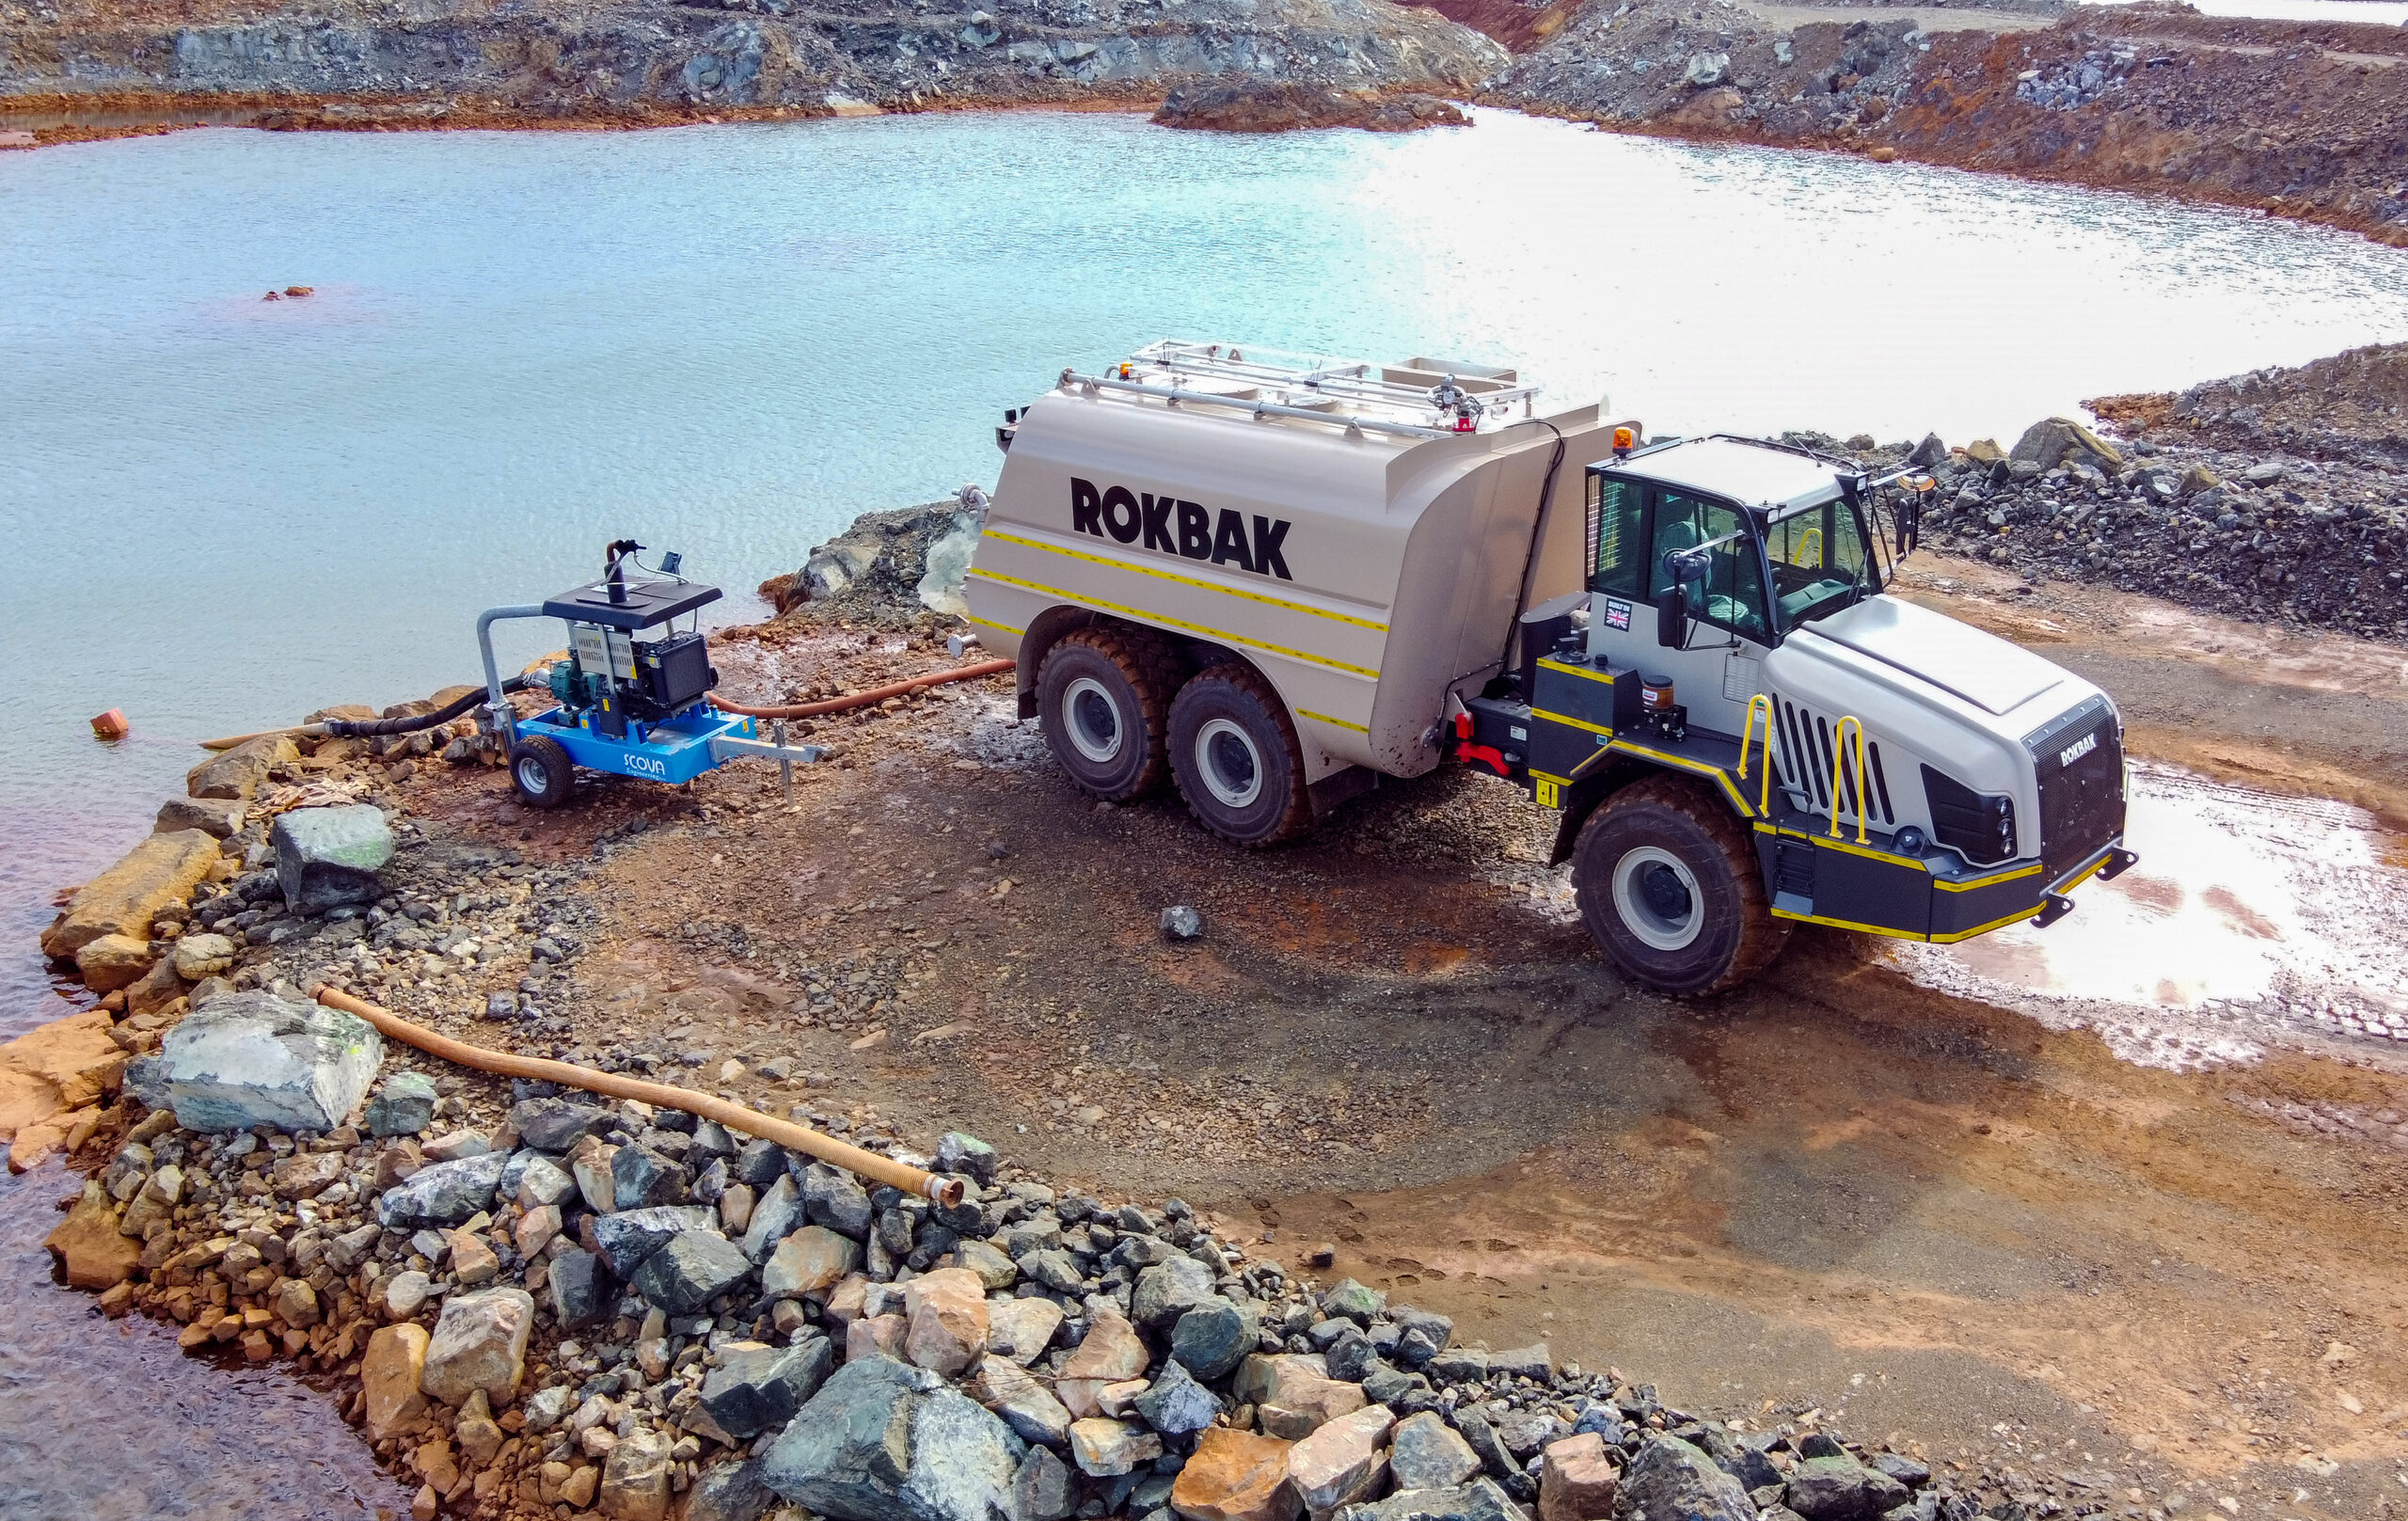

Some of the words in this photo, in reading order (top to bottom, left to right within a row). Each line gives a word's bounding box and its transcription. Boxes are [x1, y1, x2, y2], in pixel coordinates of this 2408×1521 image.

[1070, 476, 1293, 581] ROKBAK
[1608, 601, 1624, 610] BUILT
[624, 753, 666, 776] SCOVA
[2060, 732, 2097, 768] ROKBAK
